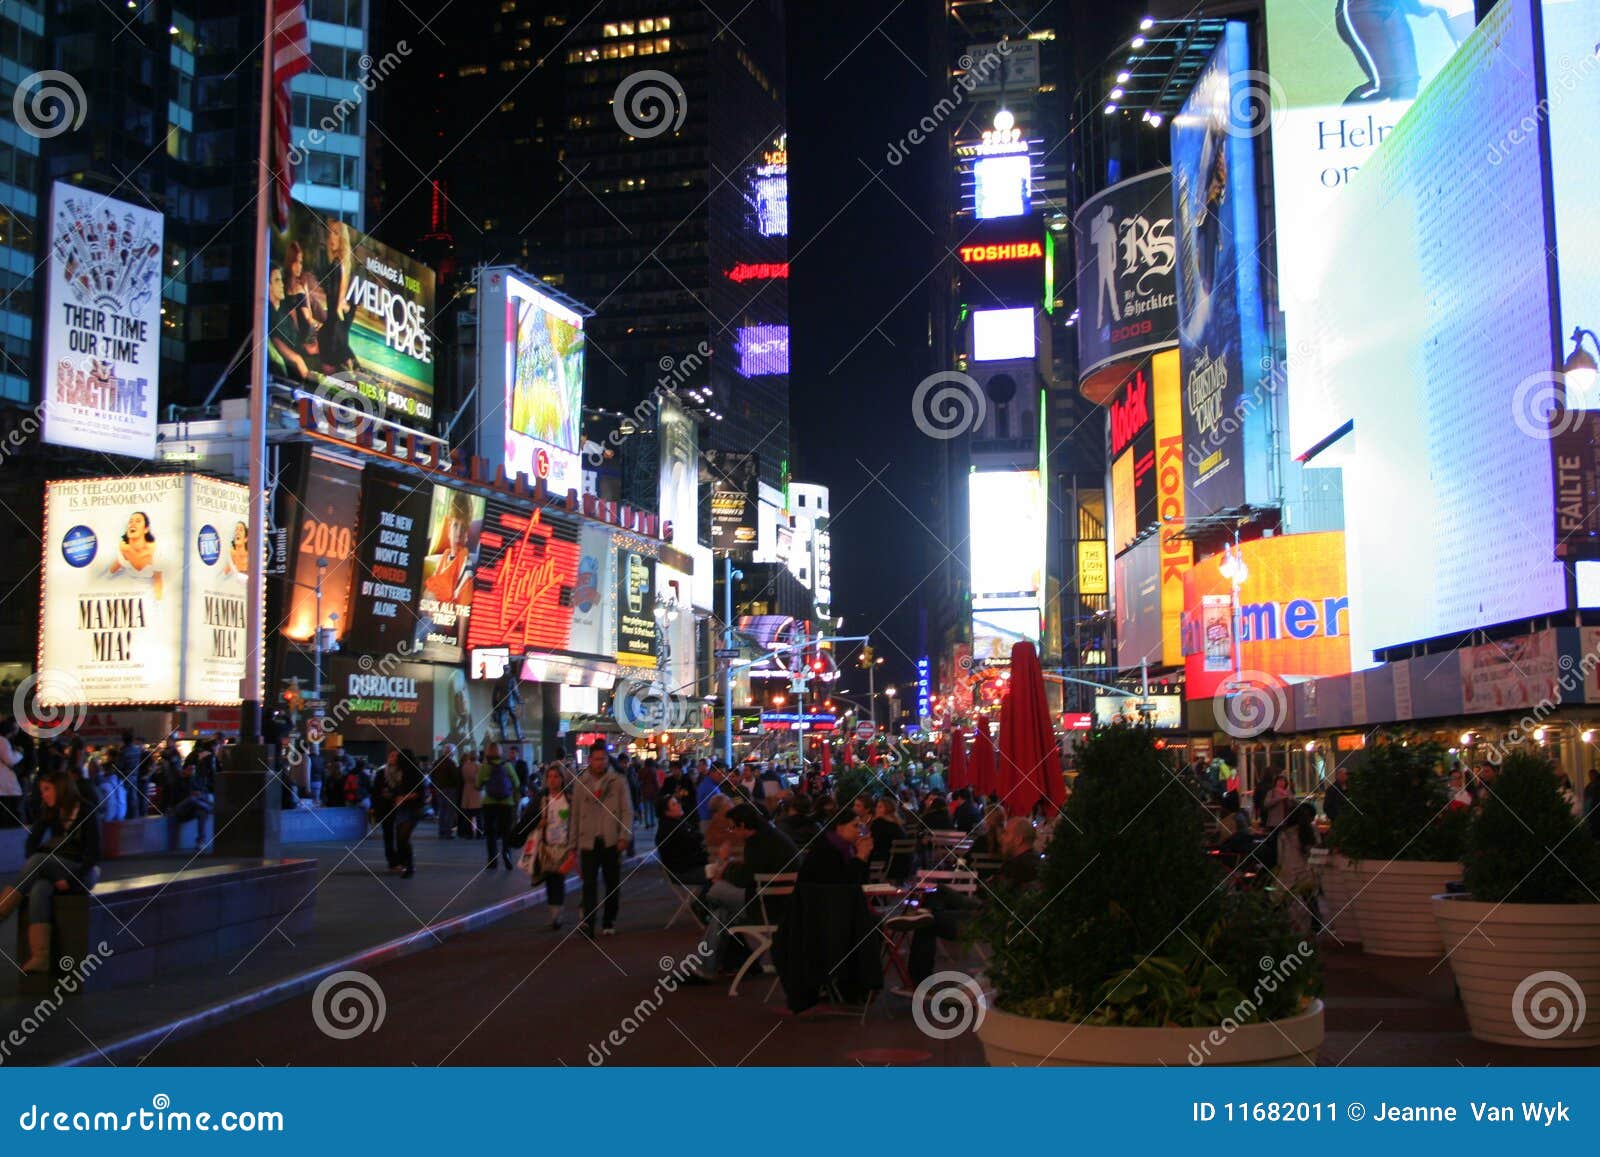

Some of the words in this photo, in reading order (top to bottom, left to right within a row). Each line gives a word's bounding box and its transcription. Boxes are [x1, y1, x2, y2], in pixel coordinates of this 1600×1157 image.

[961, 242, 1042, 263] TOSHIBA
[346, 276, 426, 334] MELROSE
[63, 302, 107, 333] THEIR
[111, 314, 148, 344] TIME
[1111, 320, 1153, 344] 2009
[69, 330, 98, 353] OUR
[102, 337, 140, 365] TIME
[386, 321, 432, 364] PLACE
[55, 357, 148, 418] RAGTIME
[1159, 434, 1190, 585] Kodak
[277, 527, 287, 561] COMING
[301, 518, 351, 561] 2010
[78, 598, 146, 630] MAMMA
[203, 596, 246, 629] MAMMA
[92, 630, 131, 661] MIA!
[213, 628, 238, 658] MIA!
[349, 673, 418, 699] DURACELL
